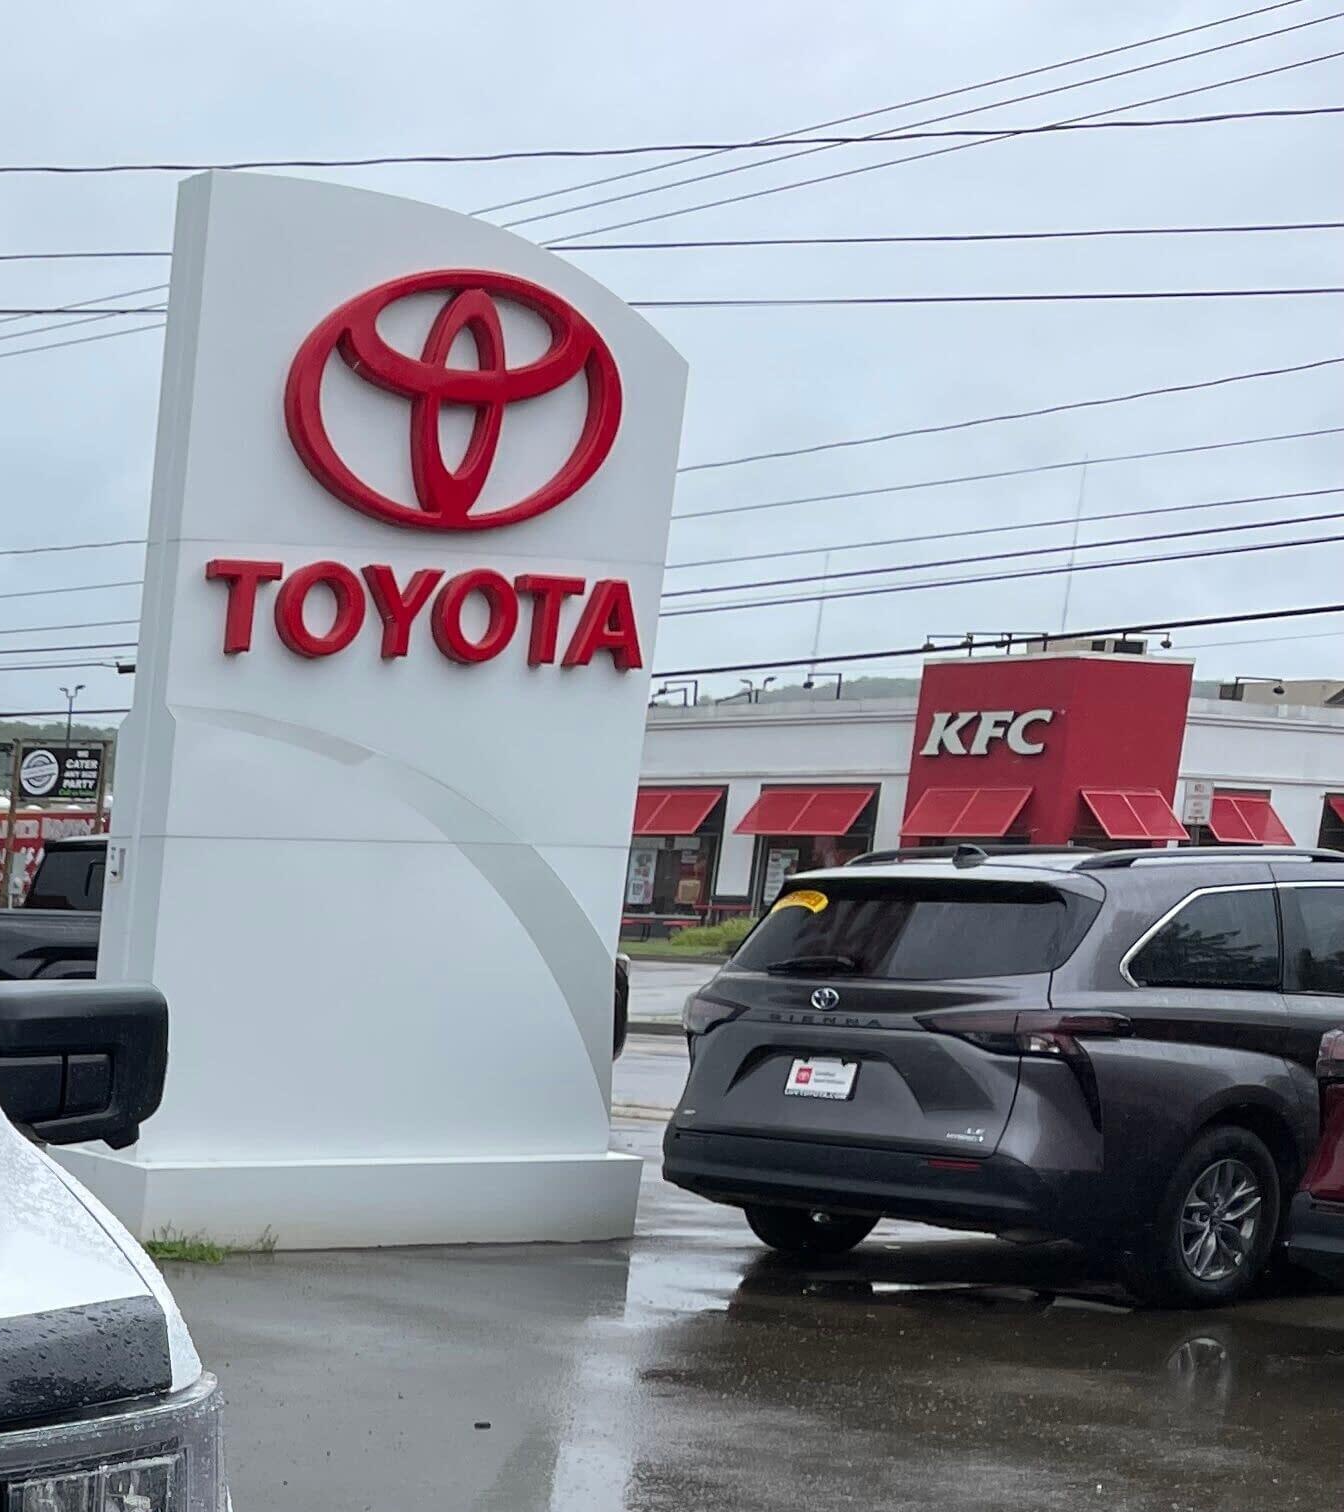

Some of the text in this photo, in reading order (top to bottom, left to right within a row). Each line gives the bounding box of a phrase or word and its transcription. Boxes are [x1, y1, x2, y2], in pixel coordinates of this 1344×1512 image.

[205, 558, 644, 671] TOYOTA
[919, 708, 1054, 756] KFC
[65, 758, 99, 770] CATER
[61, 779, 96, 789] PARTY
[769, 1013, 883, 1027] SIENNA
